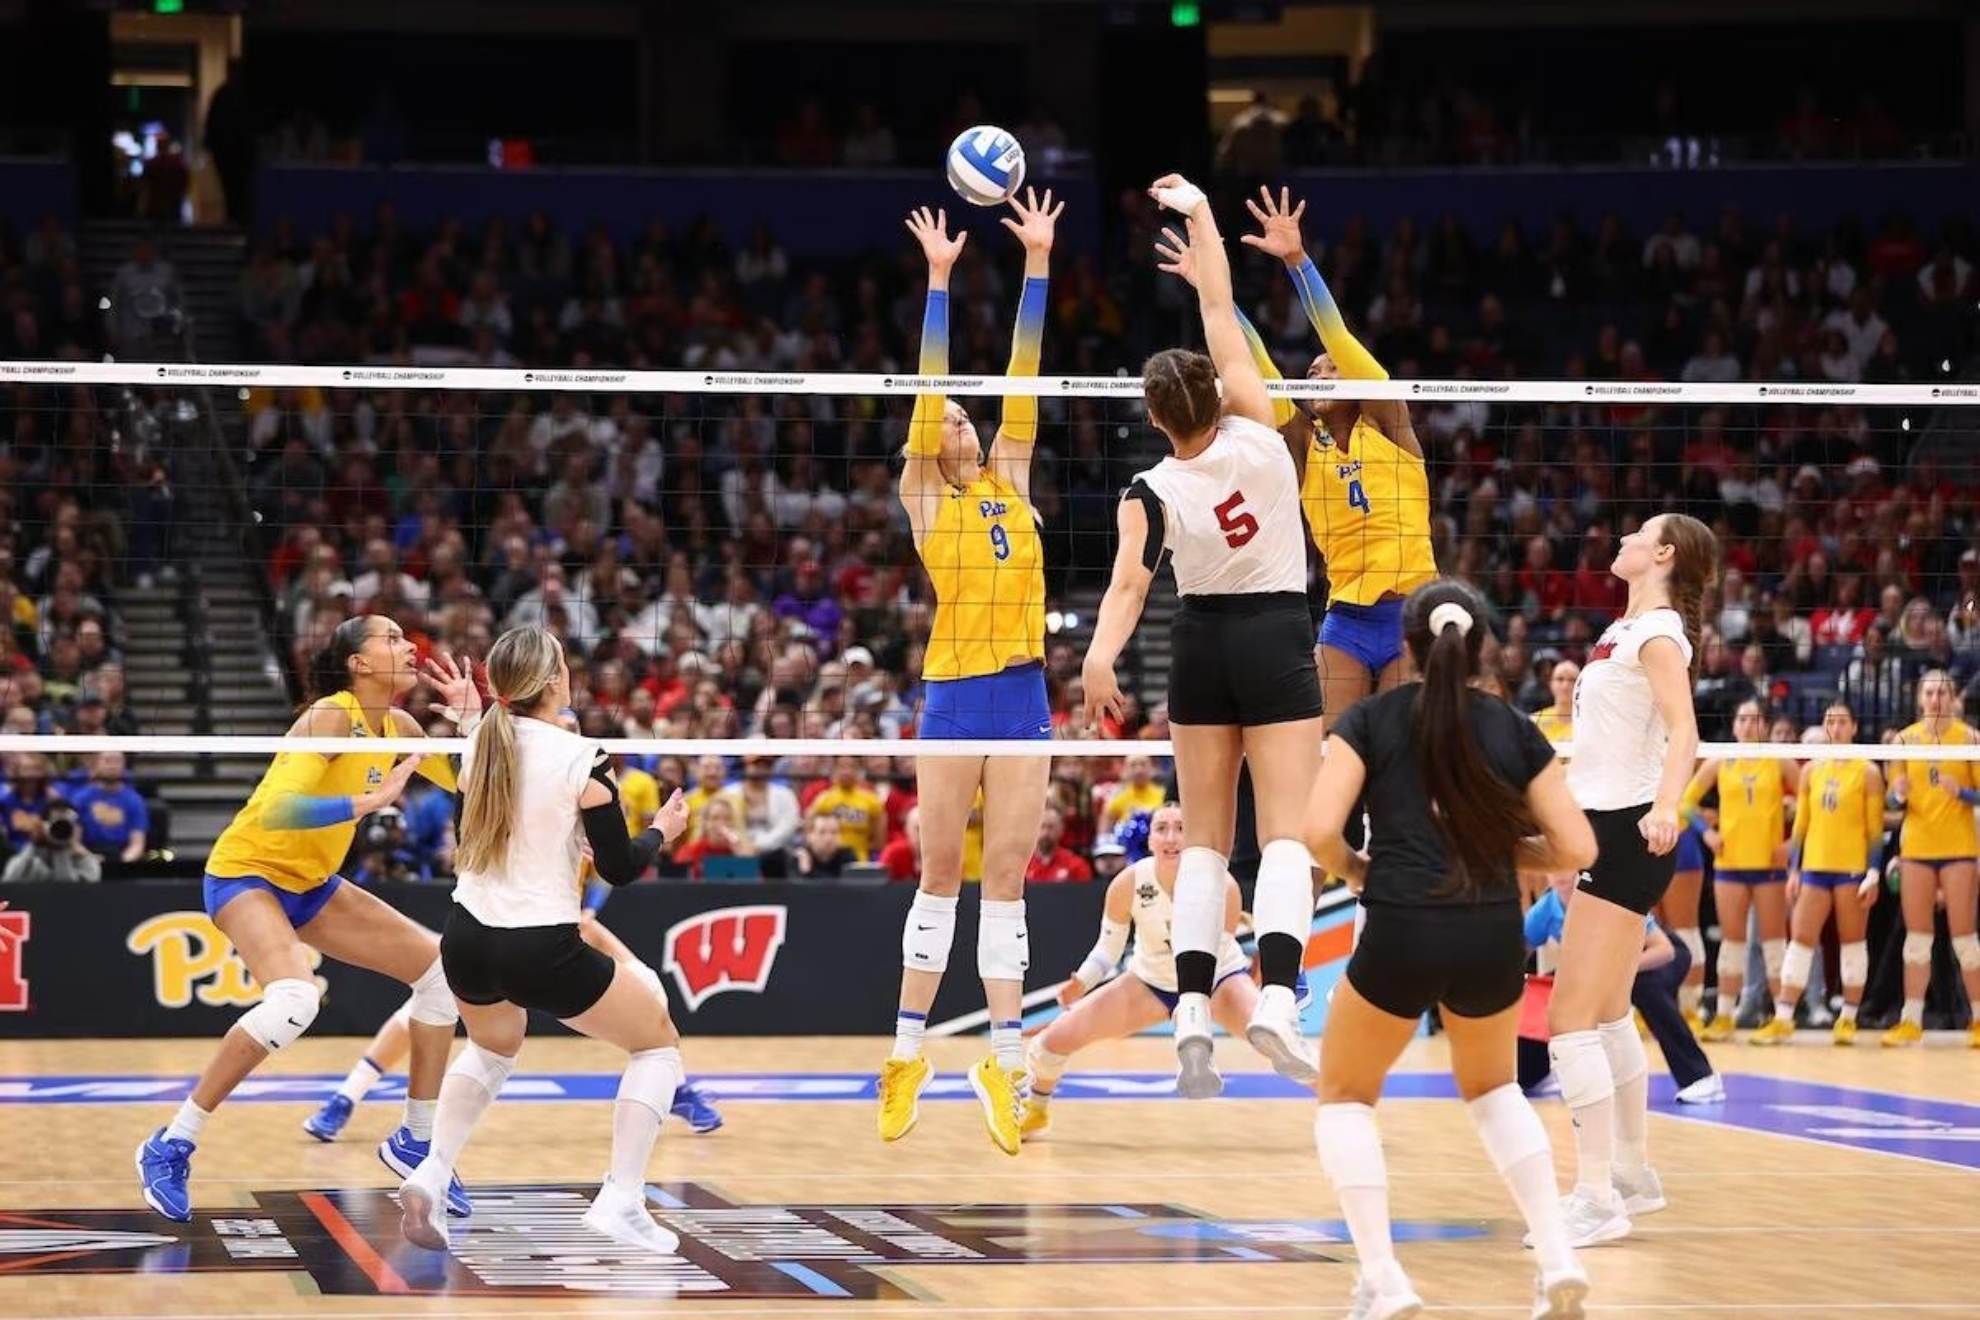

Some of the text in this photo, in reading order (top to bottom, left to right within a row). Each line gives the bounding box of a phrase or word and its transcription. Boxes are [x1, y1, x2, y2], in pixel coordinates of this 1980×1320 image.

[168, 368, 206, 377] VOLLEYBALL
[354, 371, 390, 380] VOLLEYBALL
[535, 374, 572, 382] VOLLEYBALL
[716, 376, 751, 384] VOLLEYBALL
[894, 378, 931, 387] VOLLEYBALL
[1071, 381, 1108, 390] VOLLEYBALL
[1422, 384, 1458, 392] VOLLEYBALL
[1596, 386, 1631, 394] VOLLEYBALL
[1769, 387, 1804, 395] VOLLEYBALL
[1941, 388, 1978, 397] VOLLEYBALL
[1348, 479, 1371, 514] 4
[1213, 489, 1260, 549] 5
[989, 523, 1010, 561] 9
[127, 911, 328, 1007] Pi
[662, 905, 787, 1013] W
